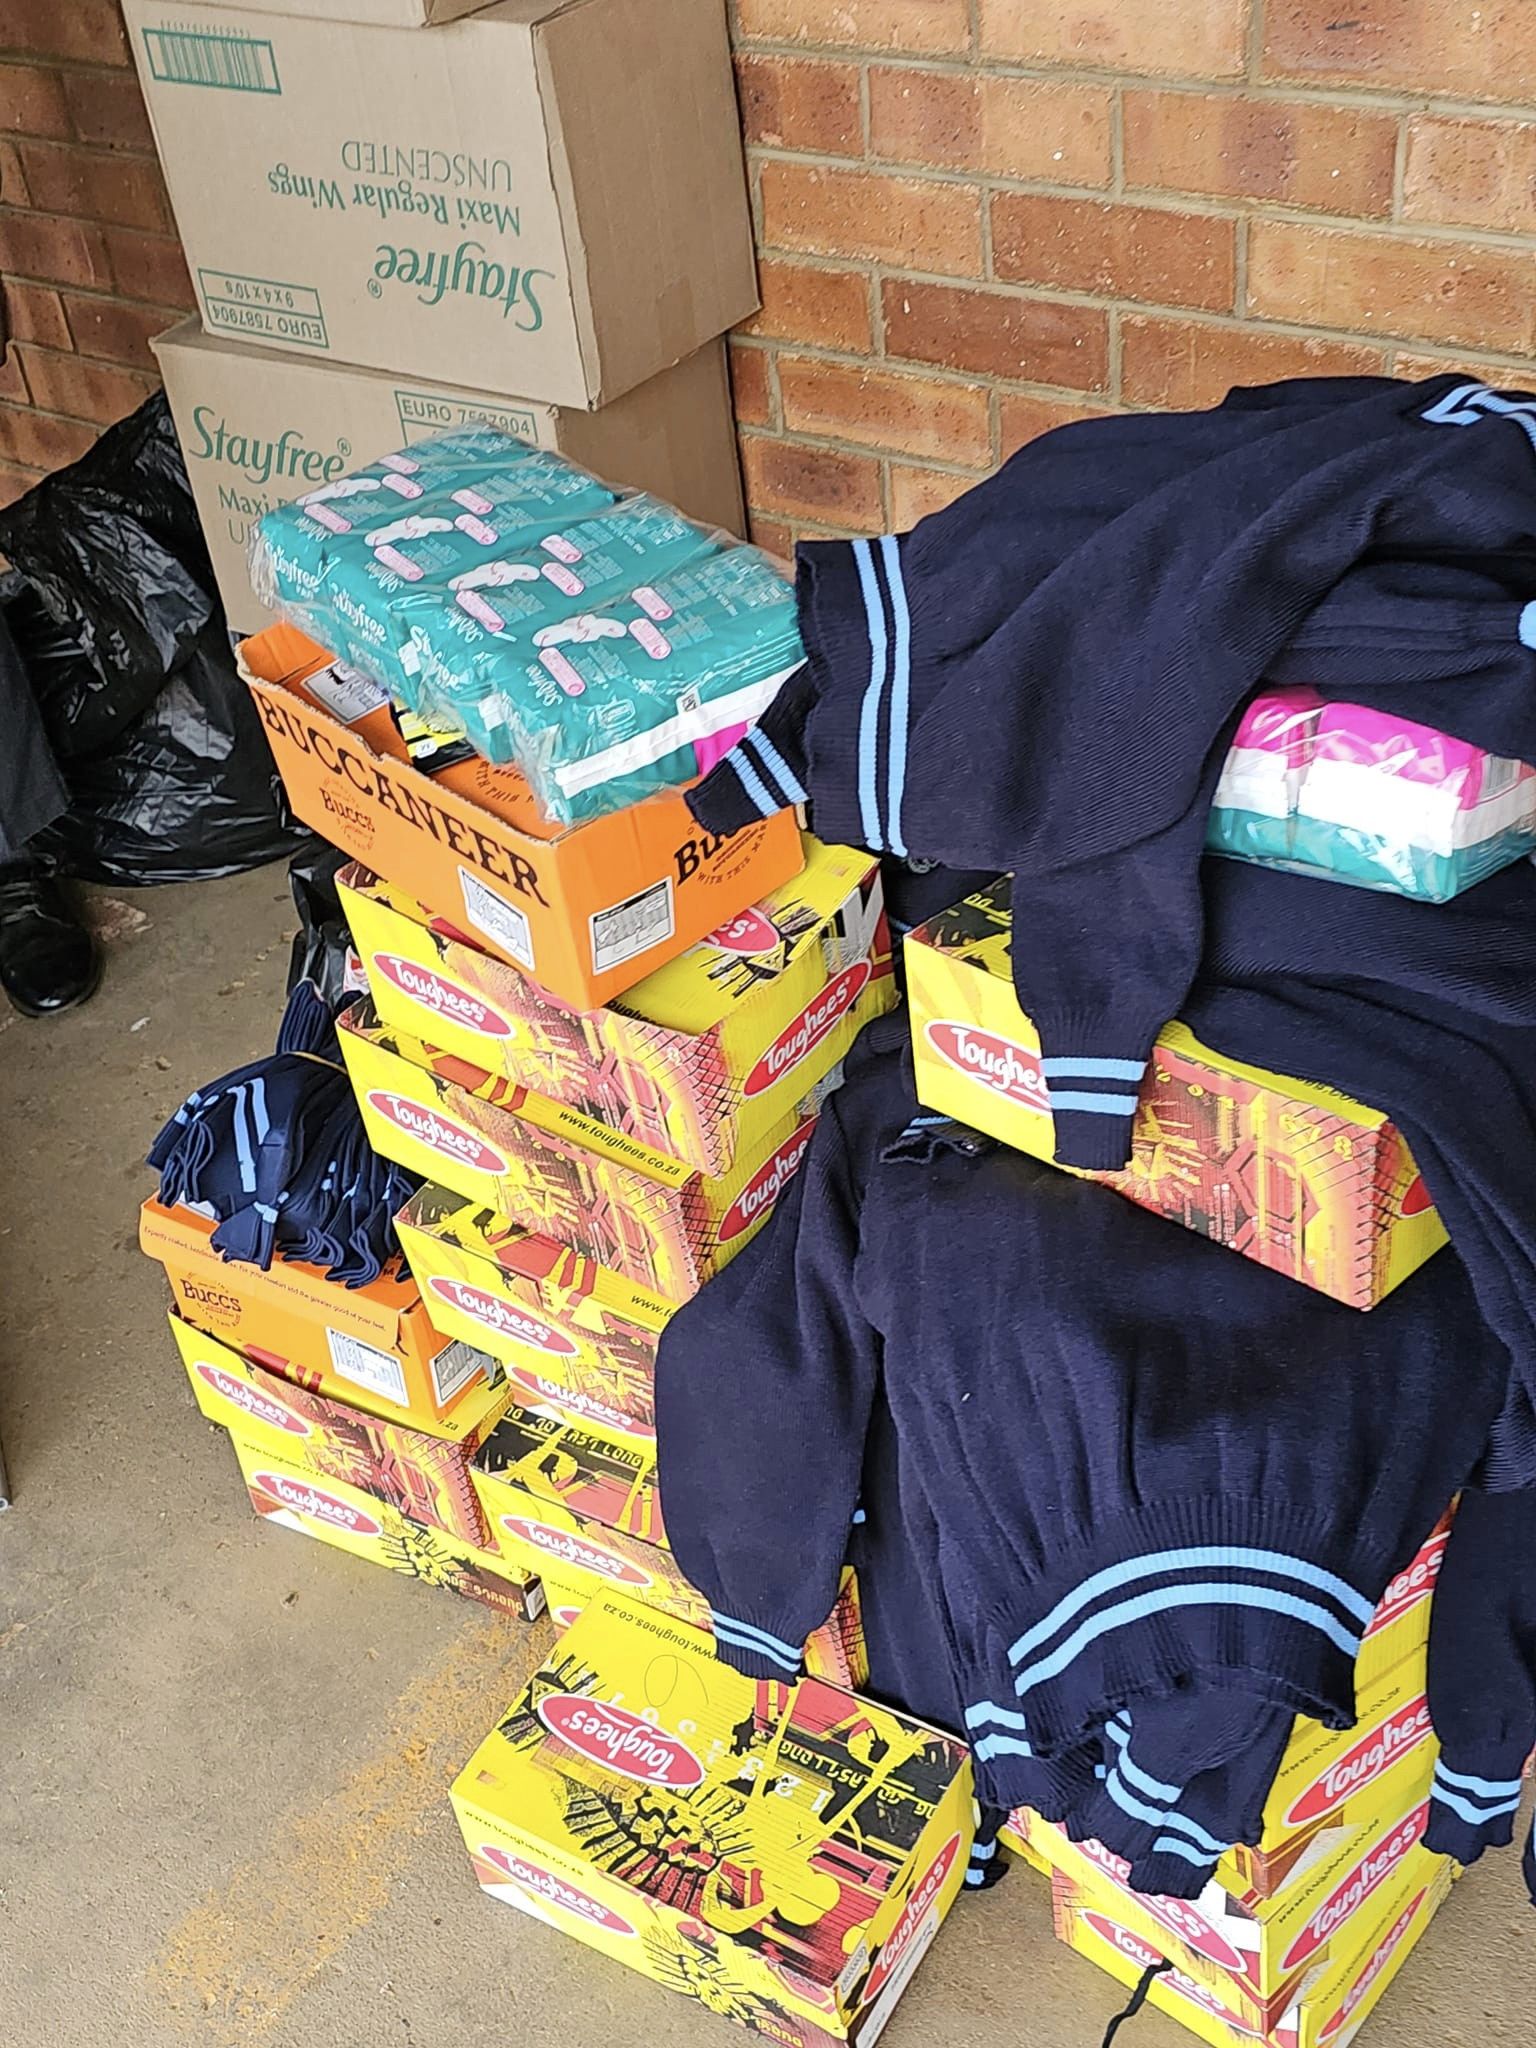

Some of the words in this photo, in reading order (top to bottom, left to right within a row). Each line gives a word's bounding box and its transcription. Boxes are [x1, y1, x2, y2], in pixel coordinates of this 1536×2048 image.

[268, 162, 346, 210] Wings
[342, 140, 511, 192] UNSCENTED
[353, 179, 449, 225] Regular
[457, 198, 520, 236] Maxi
[212, 304, 273, 331] 7587904
[374, 241, 555, 331] Stayfree
[277, 317, 322, 340] EURO
[403, 400, 451, 422] EURO
[188, 406, 344, 484] Stayfree
[219, 484, 270, 516] Maxi
[253, 686, 550, 908] BUCCANEER
[389, 957, 487, 1023] Toughees
[762, 981, 849, 1076] Toughees
[950, 1027, 1049, 1096] Toughe
[389, 1095, 483, 1159] Toughees
[559, 1111, 681, 1177] www.toughees.co.za
[735, 1140, 809, 1219] Toughee
[449, 1282, 551, 1341] Toughees
[208, 1368, 289, 1425] Toughees
[270, 1476, 358, 1526] Toughees
[521, 1521, 625, 1575] Toughees
[565, 1710, 675, 1781] Toughees
[1319, 1705, 1431, 1798] Toughee
[501, 1850, 609, 1920] Toughees
[1309, 1824, 1418, 1939] Toughees
[878, 1859, 946, 1972] Toughees
